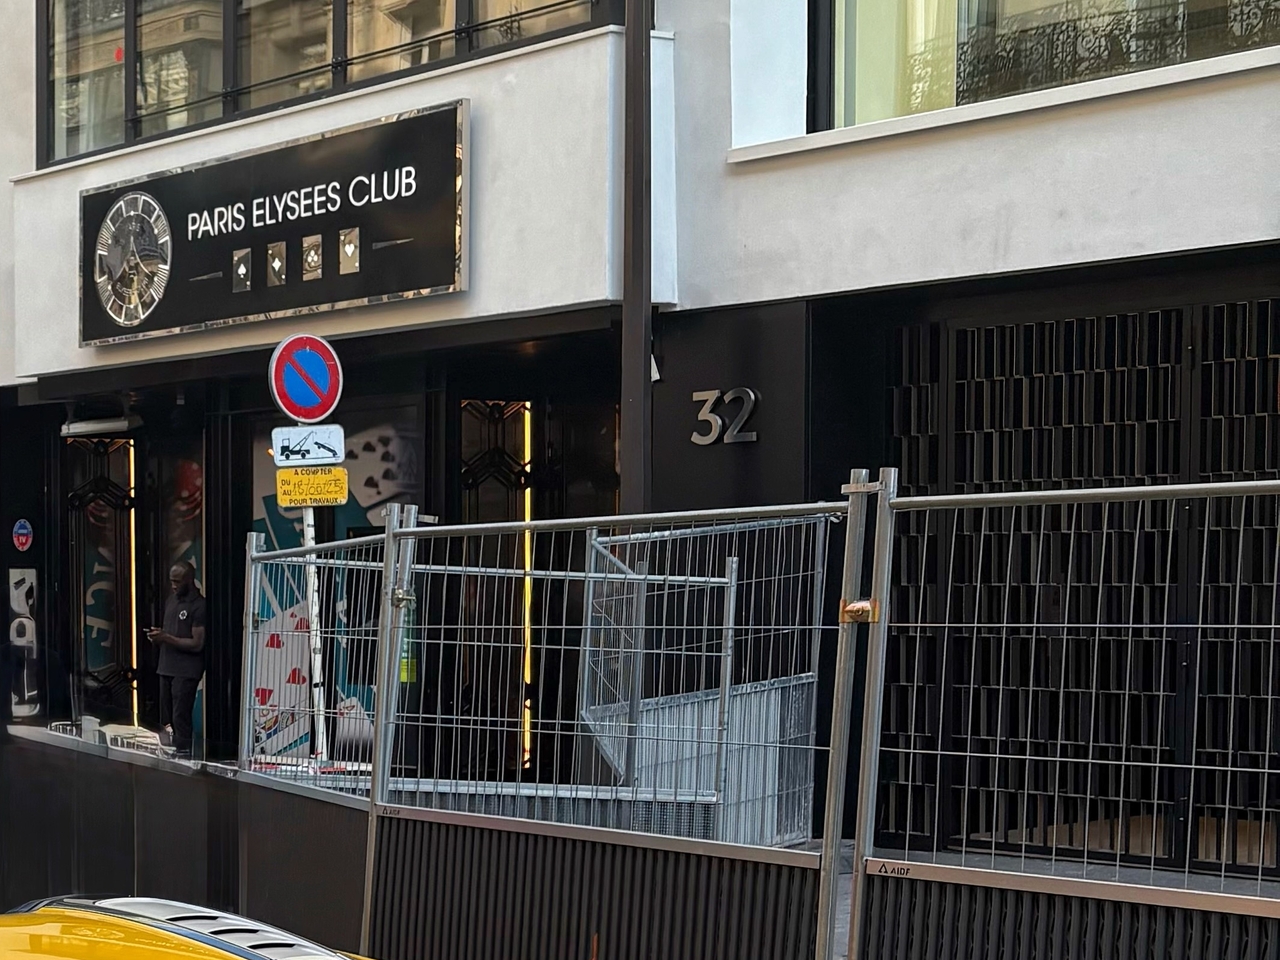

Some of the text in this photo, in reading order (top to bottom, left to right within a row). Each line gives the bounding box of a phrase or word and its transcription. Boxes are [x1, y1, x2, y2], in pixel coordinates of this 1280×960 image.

[187, 165, 417, 241] PARIS ELYSEES CLUB
[690, 387, 758, 446] 32
